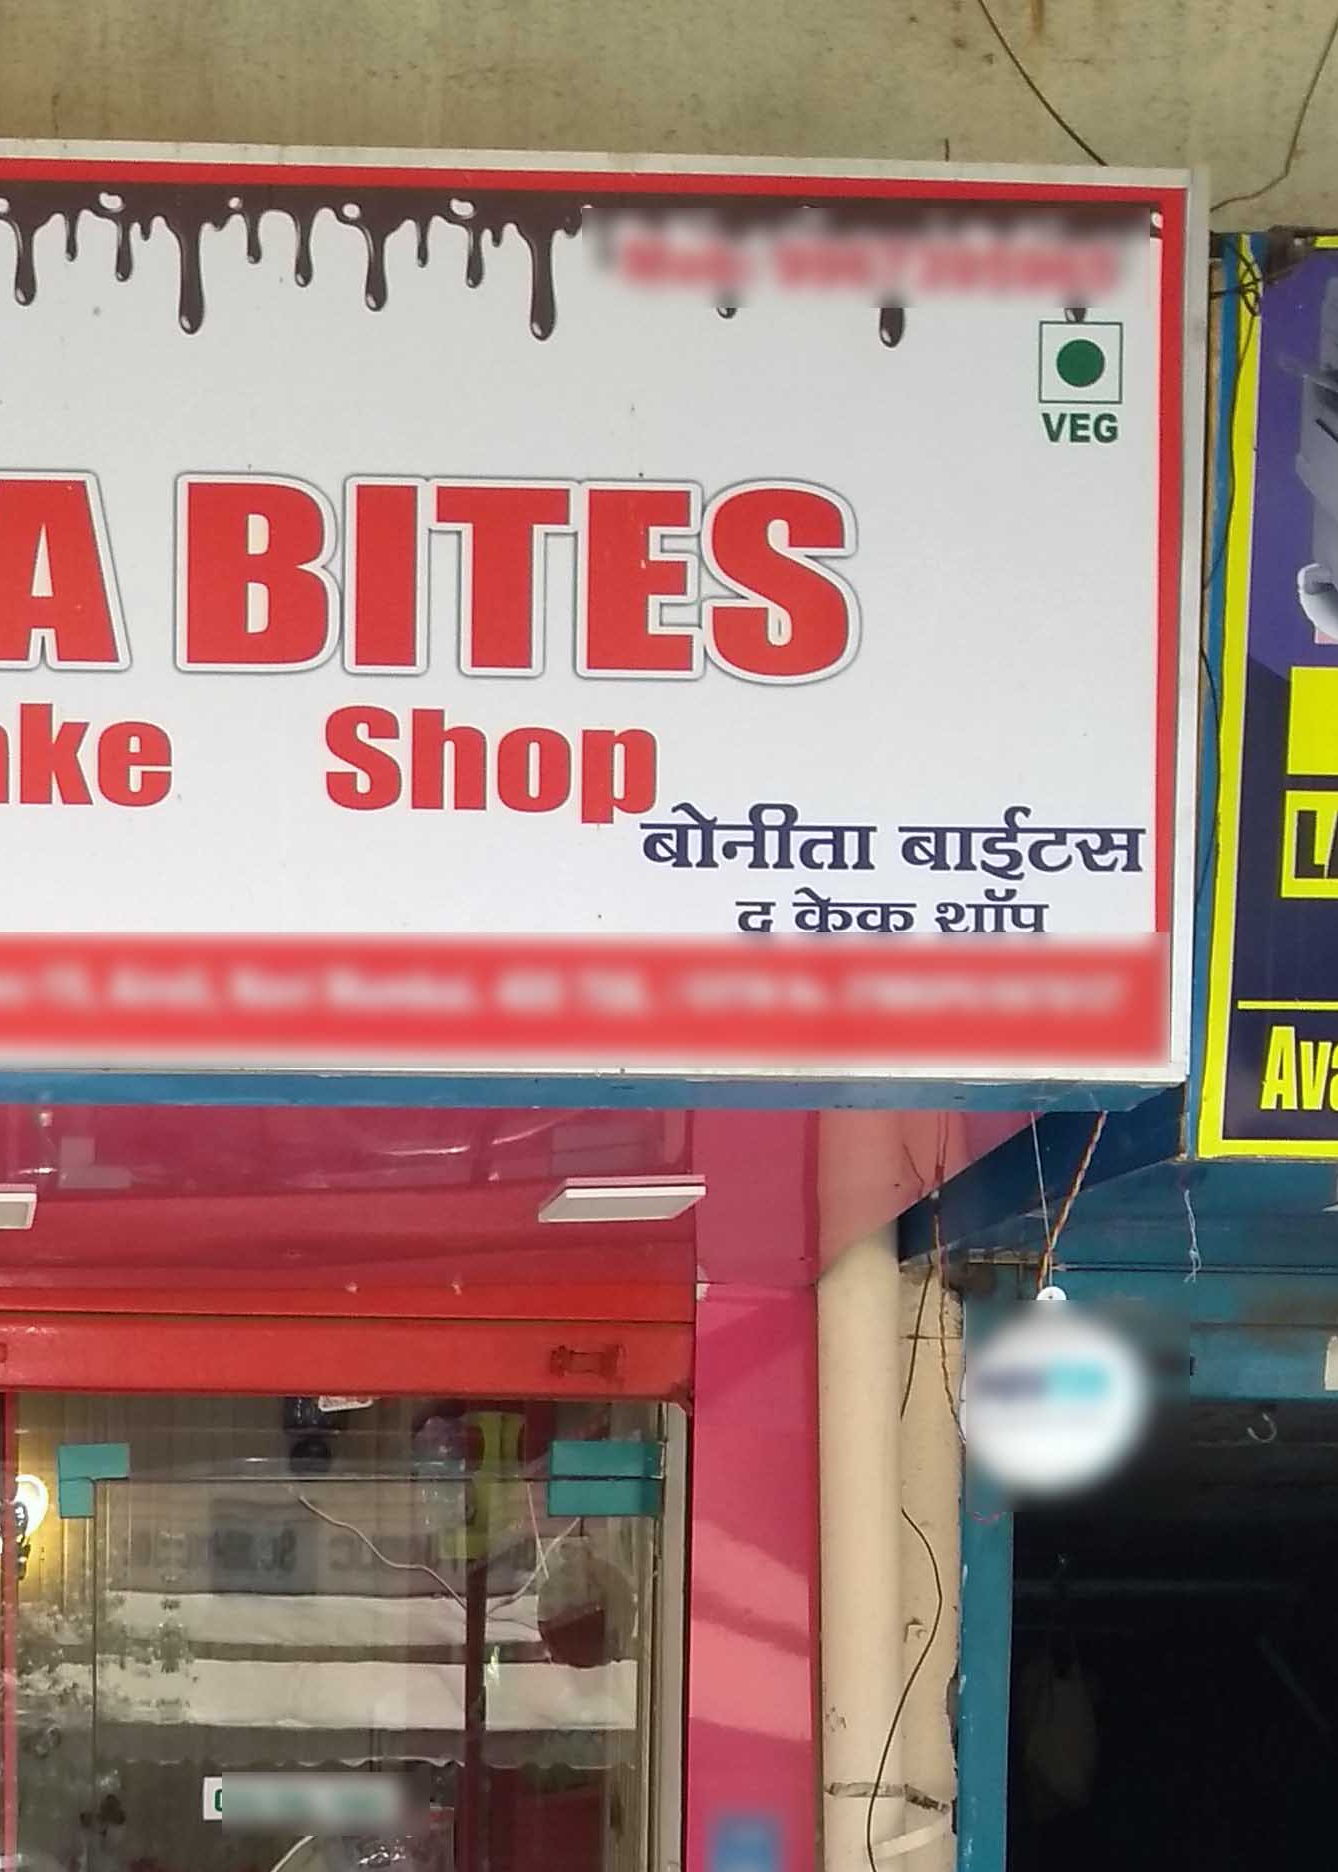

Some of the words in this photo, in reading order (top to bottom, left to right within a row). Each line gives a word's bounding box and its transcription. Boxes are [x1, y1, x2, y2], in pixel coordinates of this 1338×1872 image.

[1042, 412, 1118, 443] VEG
[182, 478, 852, 680] BITES
[323, 705, 657, 825] Shop
[640, 802, 877, 870] बोनीता
[898, 806, 1146, 881] बाईटस
[735, 901, 776, 933] द
[792, 887, 917, 933] केक
[935, 888, 1050, 933] शॉप
